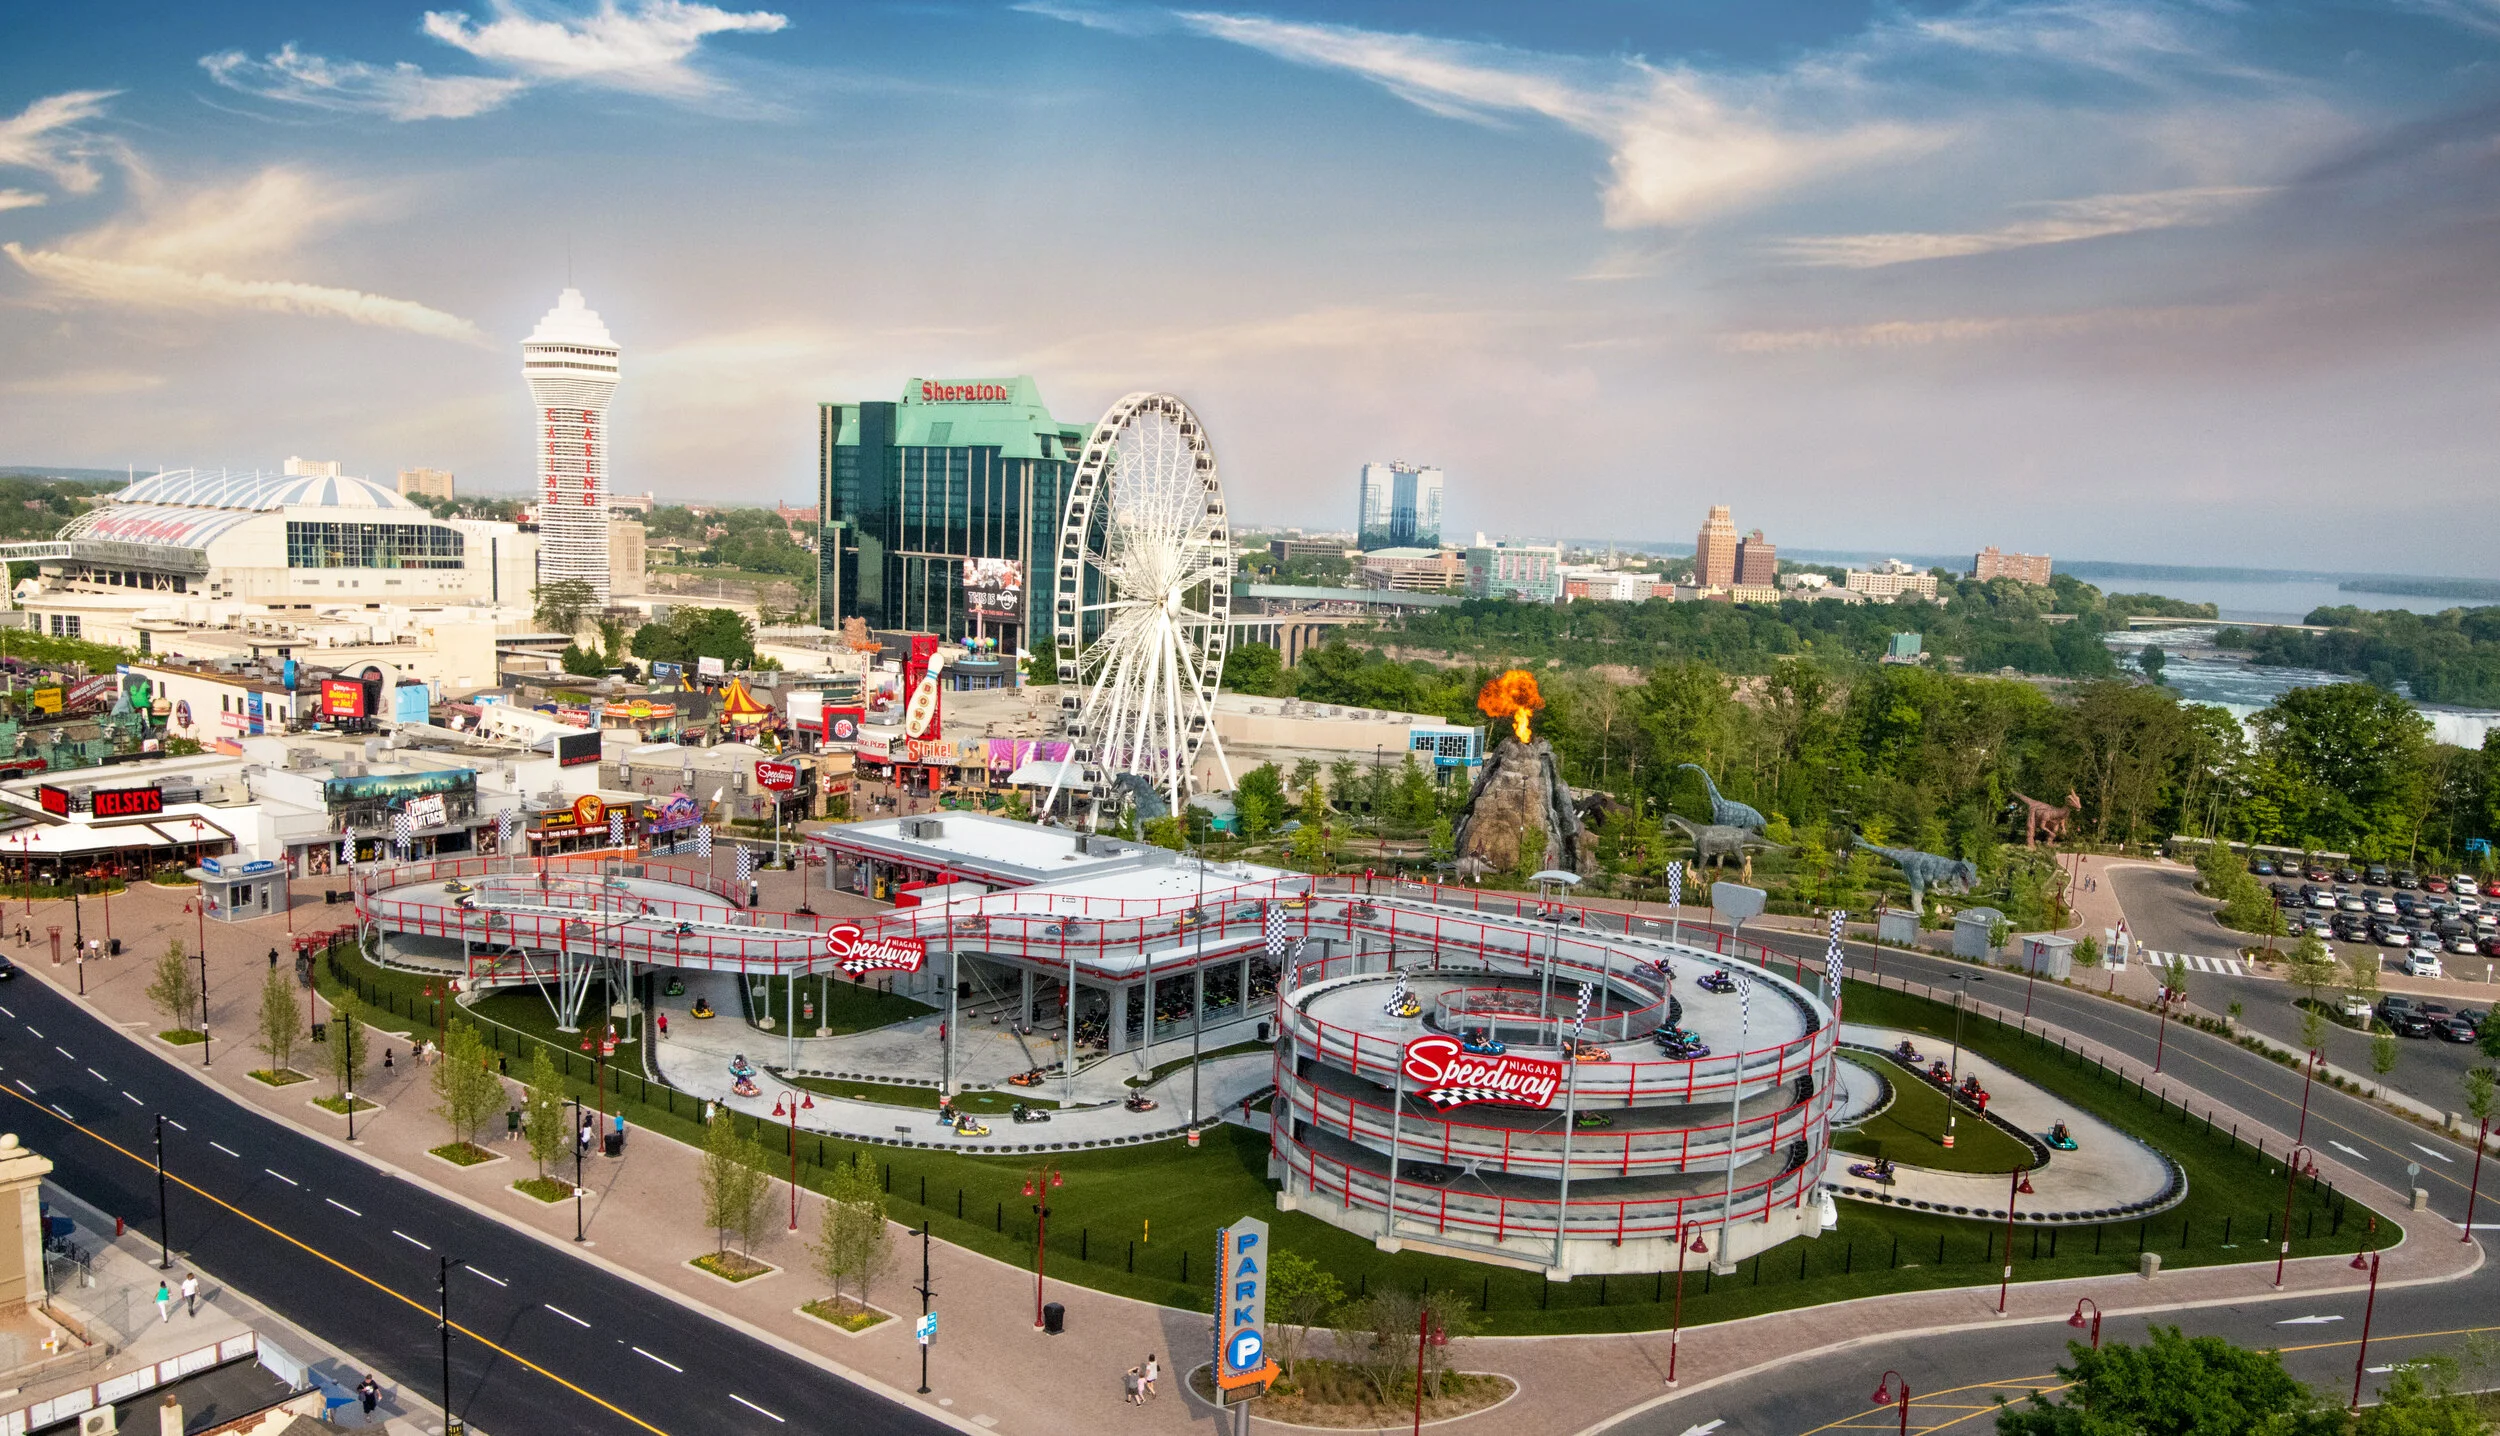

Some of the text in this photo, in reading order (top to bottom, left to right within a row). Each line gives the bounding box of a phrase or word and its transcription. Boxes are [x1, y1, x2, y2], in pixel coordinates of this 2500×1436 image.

[922, 381, 1006, 400] Sheraton
[547, 408, 557, 504] CASINO
[583, 410, 594, 506] CASINO
[968, 591, 987, 605] THIS
[987, 593, 996, 606] IS
[911, 683, 931, 731] BOWL
[908, 740, 951, 762] Strike!
[758, 764, 794, 784] Speedway
[95, 790, 160, 815] KELSEYS
[243, 863, 272, 872] SkyWheel
[827, 926, 921, 971] Speedway
[892, 939, 922, 950] NIAGARA
[1405, 1040, 1556, 1106] Speedway
[1509, 1061, 1557, 1076] NIAGARA
[1234, 1233, 1259, 1327] PARK
[1237, 1337, 1261, 1366] P
